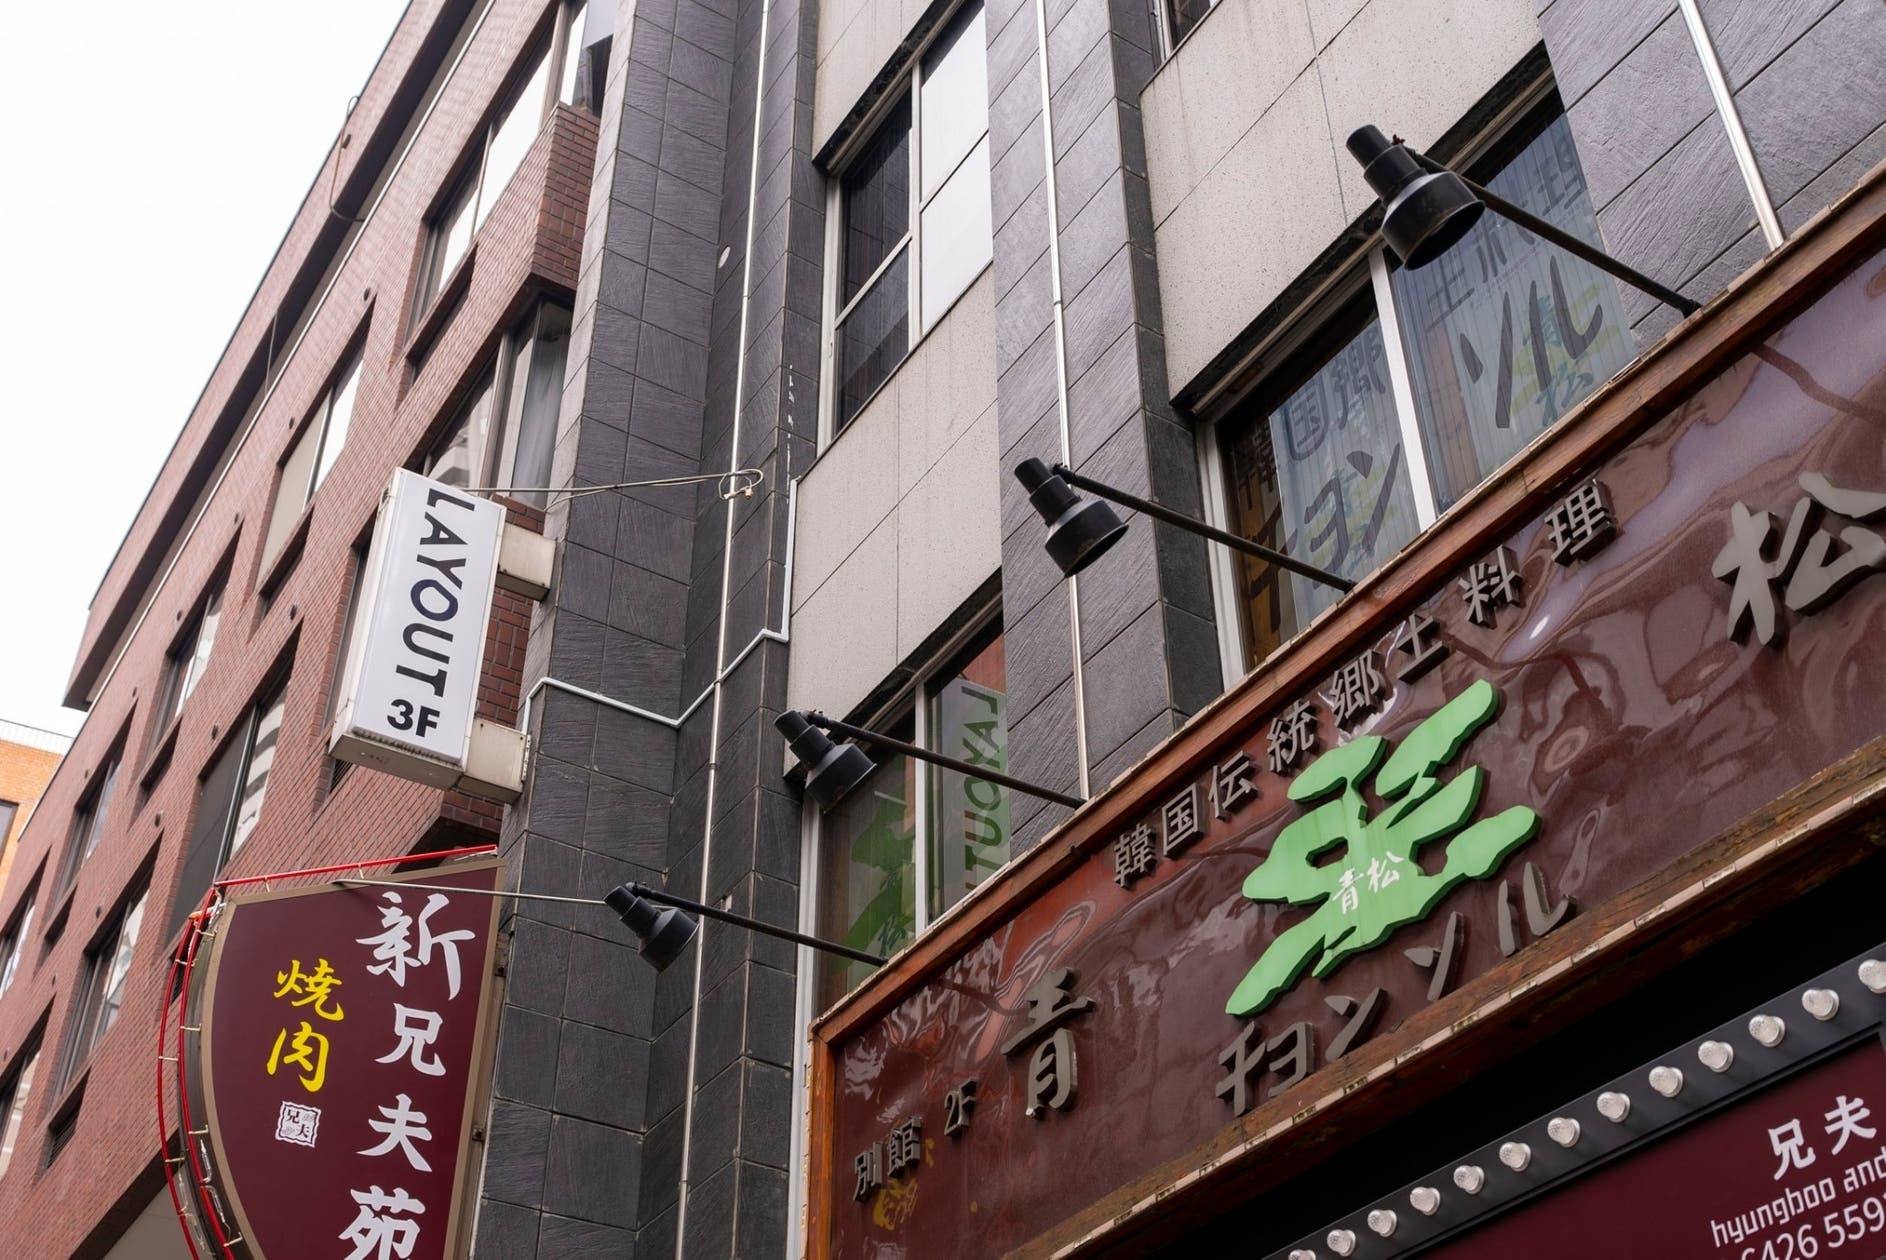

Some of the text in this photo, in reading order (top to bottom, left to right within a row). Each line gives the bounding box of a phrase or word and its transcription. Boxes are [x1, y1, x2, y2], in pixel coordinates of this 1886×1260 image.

[1246, 255, 1603, 632] チョンソル
[395, 487, 476, 699] LAYOUT
[386, 698, 441, 738] 3F
[1112, 478, 1615, 888] 韓国伝統郷土料理
[1332, 850, 1405, 915] 青松
[267, 958, 345, 1093] 焼肉
[1215, 861, 1577, 1118] チョンソル
[338, 890, 476, 1260] 新兄夫苑
[853, 1077, 980, 1201] 別館 2F
[1766, 1094, 1878, 1182] 兄夫
[1709, 1177, 1837, 1249] hyungboo
[1822, 1190, 1886, 1250] 559
